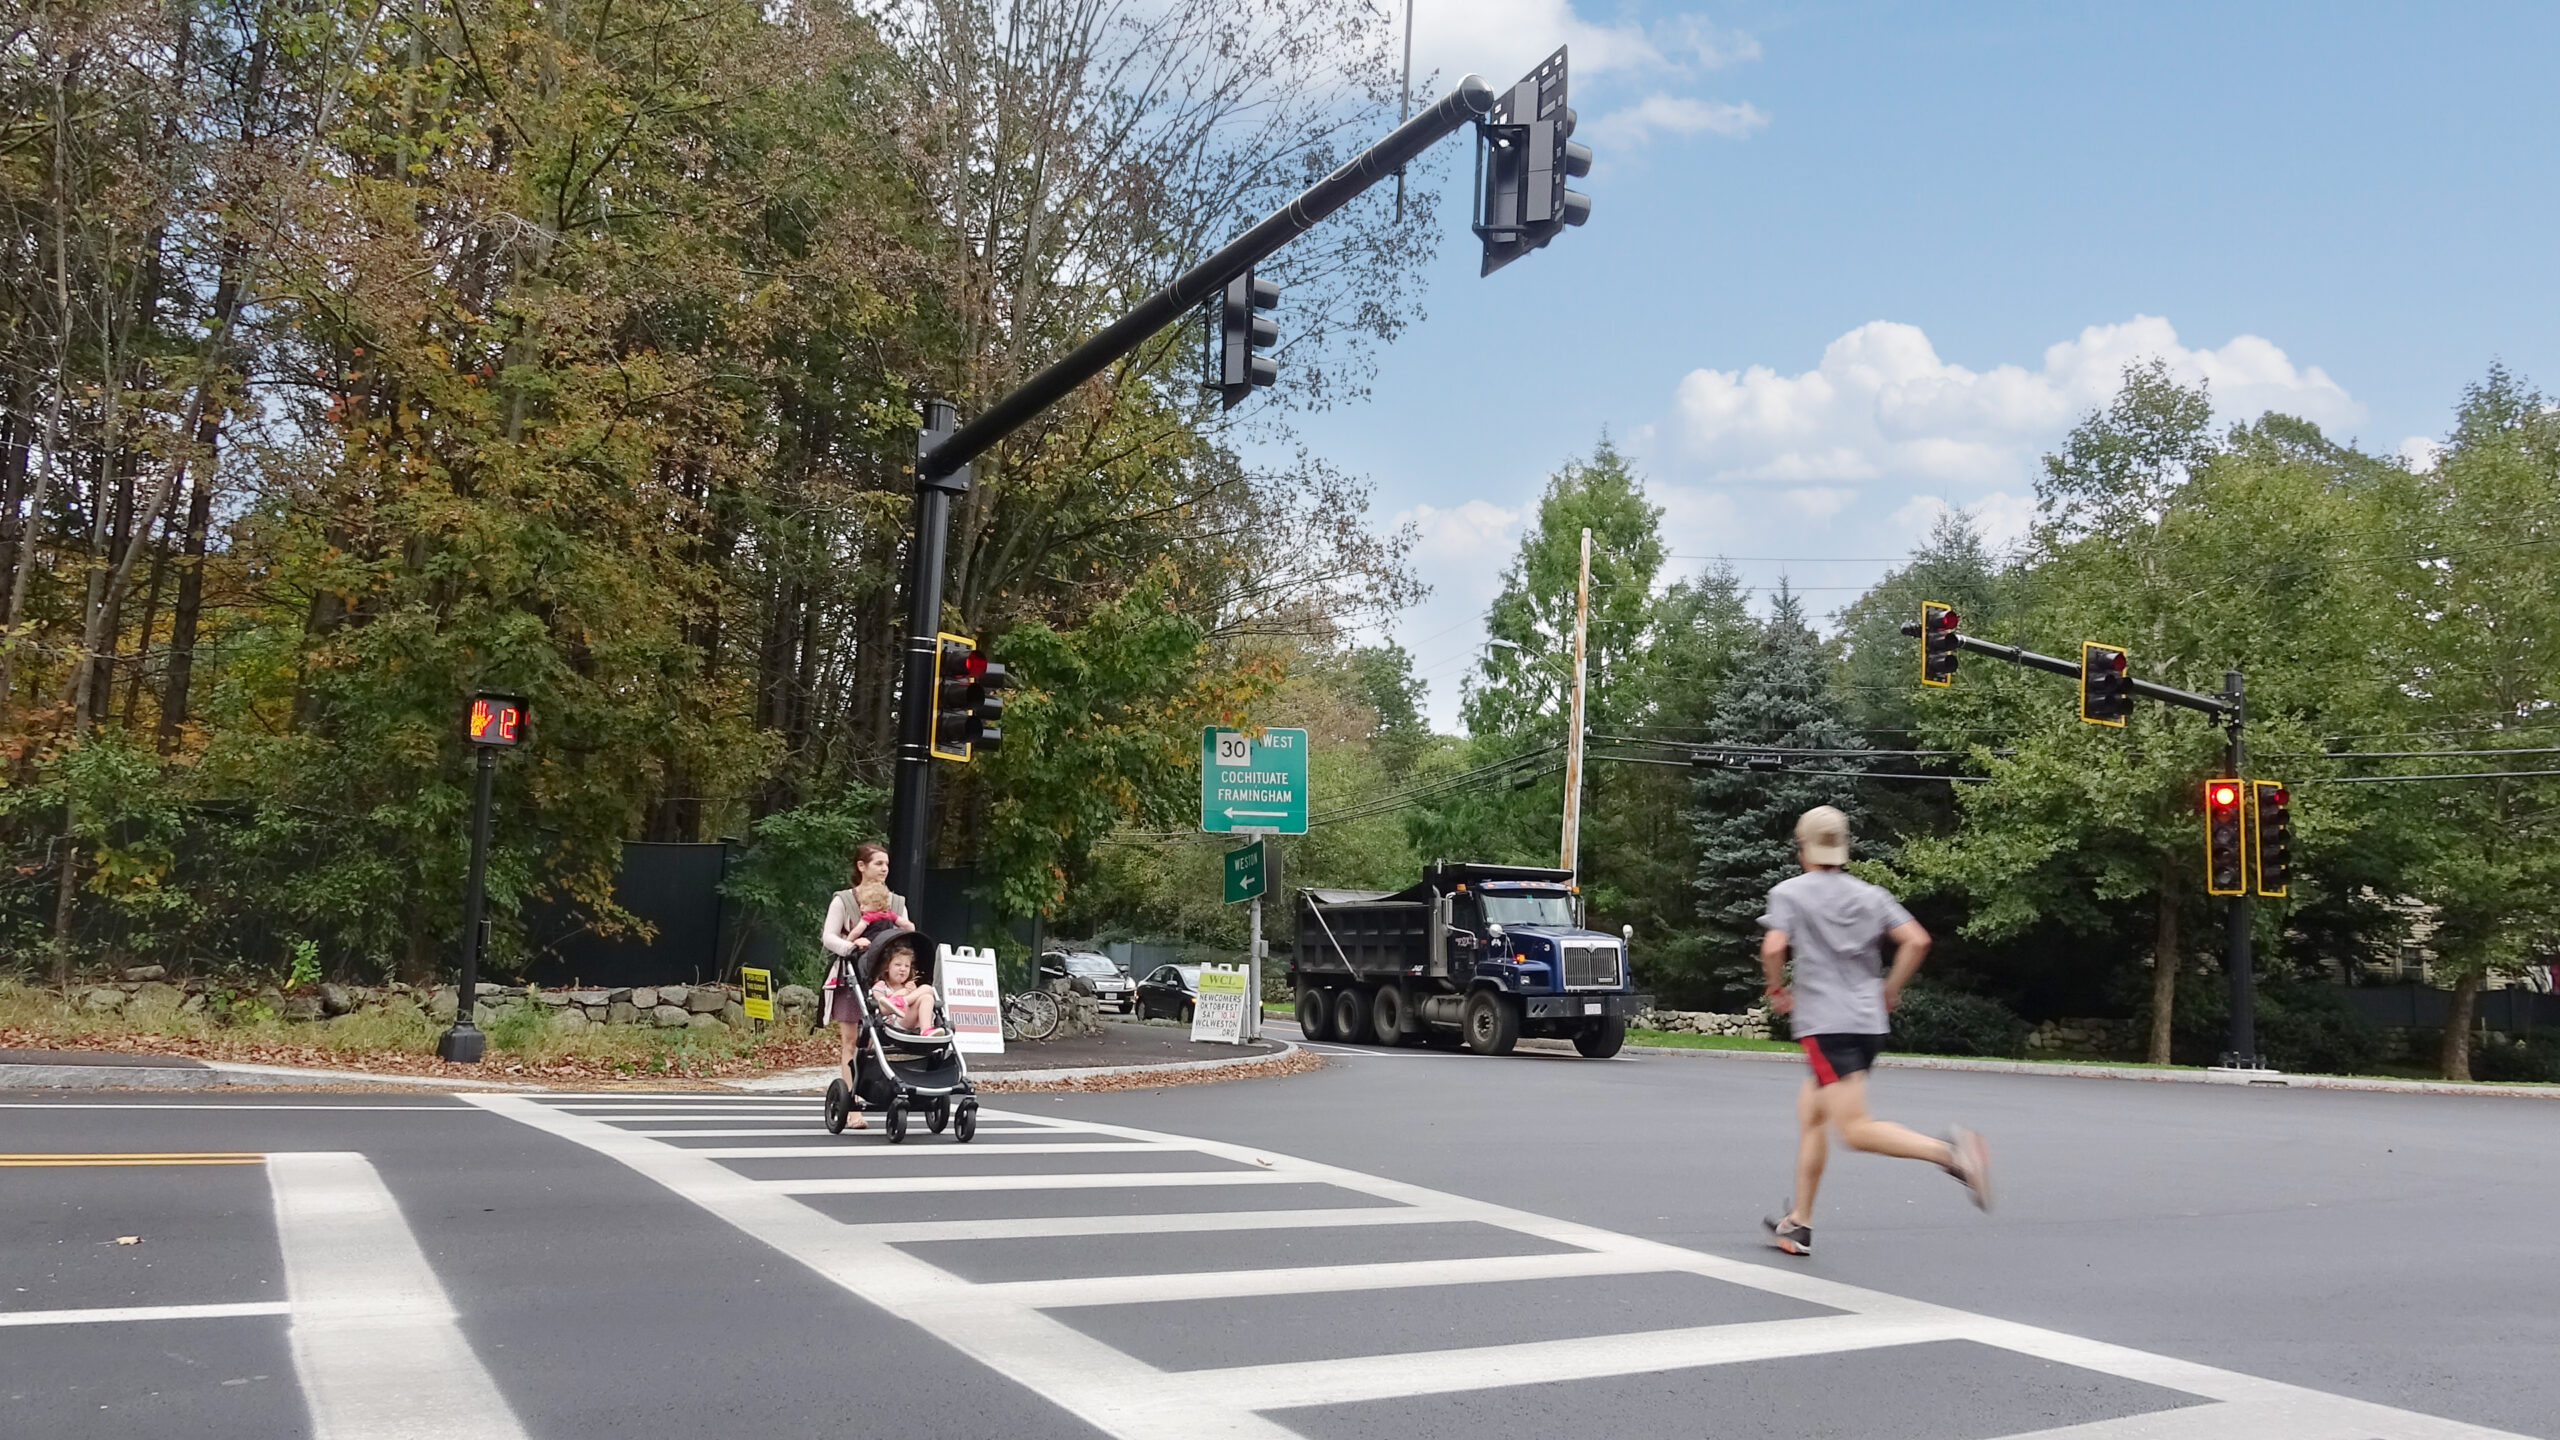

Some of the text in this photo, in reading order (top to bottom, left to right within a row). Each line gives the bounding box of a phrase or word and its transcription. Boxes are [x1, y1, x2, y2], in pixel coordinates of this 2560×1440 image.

[498, 707, 520, 740] 12
[1221, 734, 1293, 758] 30 WEST
[1221, 771, 1289, 785] COCHITUATE
[1218, 788, 1292, 803] FRAMINGHAM
[1234, 851, 1258, 872] WESTON
[1543, 943, 1551, 952] 3
[956, 978, 984, 986] WESTON
[1209, 975, 1236, 985] WCL
[948, 988, 994, 998] SKATING CLUB
[1199, 994, 1241, 1003] NEWCOMERS
[1200, 1003, 1238, 1011] OKTOBFEST
[952, 1013, 997, 1026] JOIN NOW!
